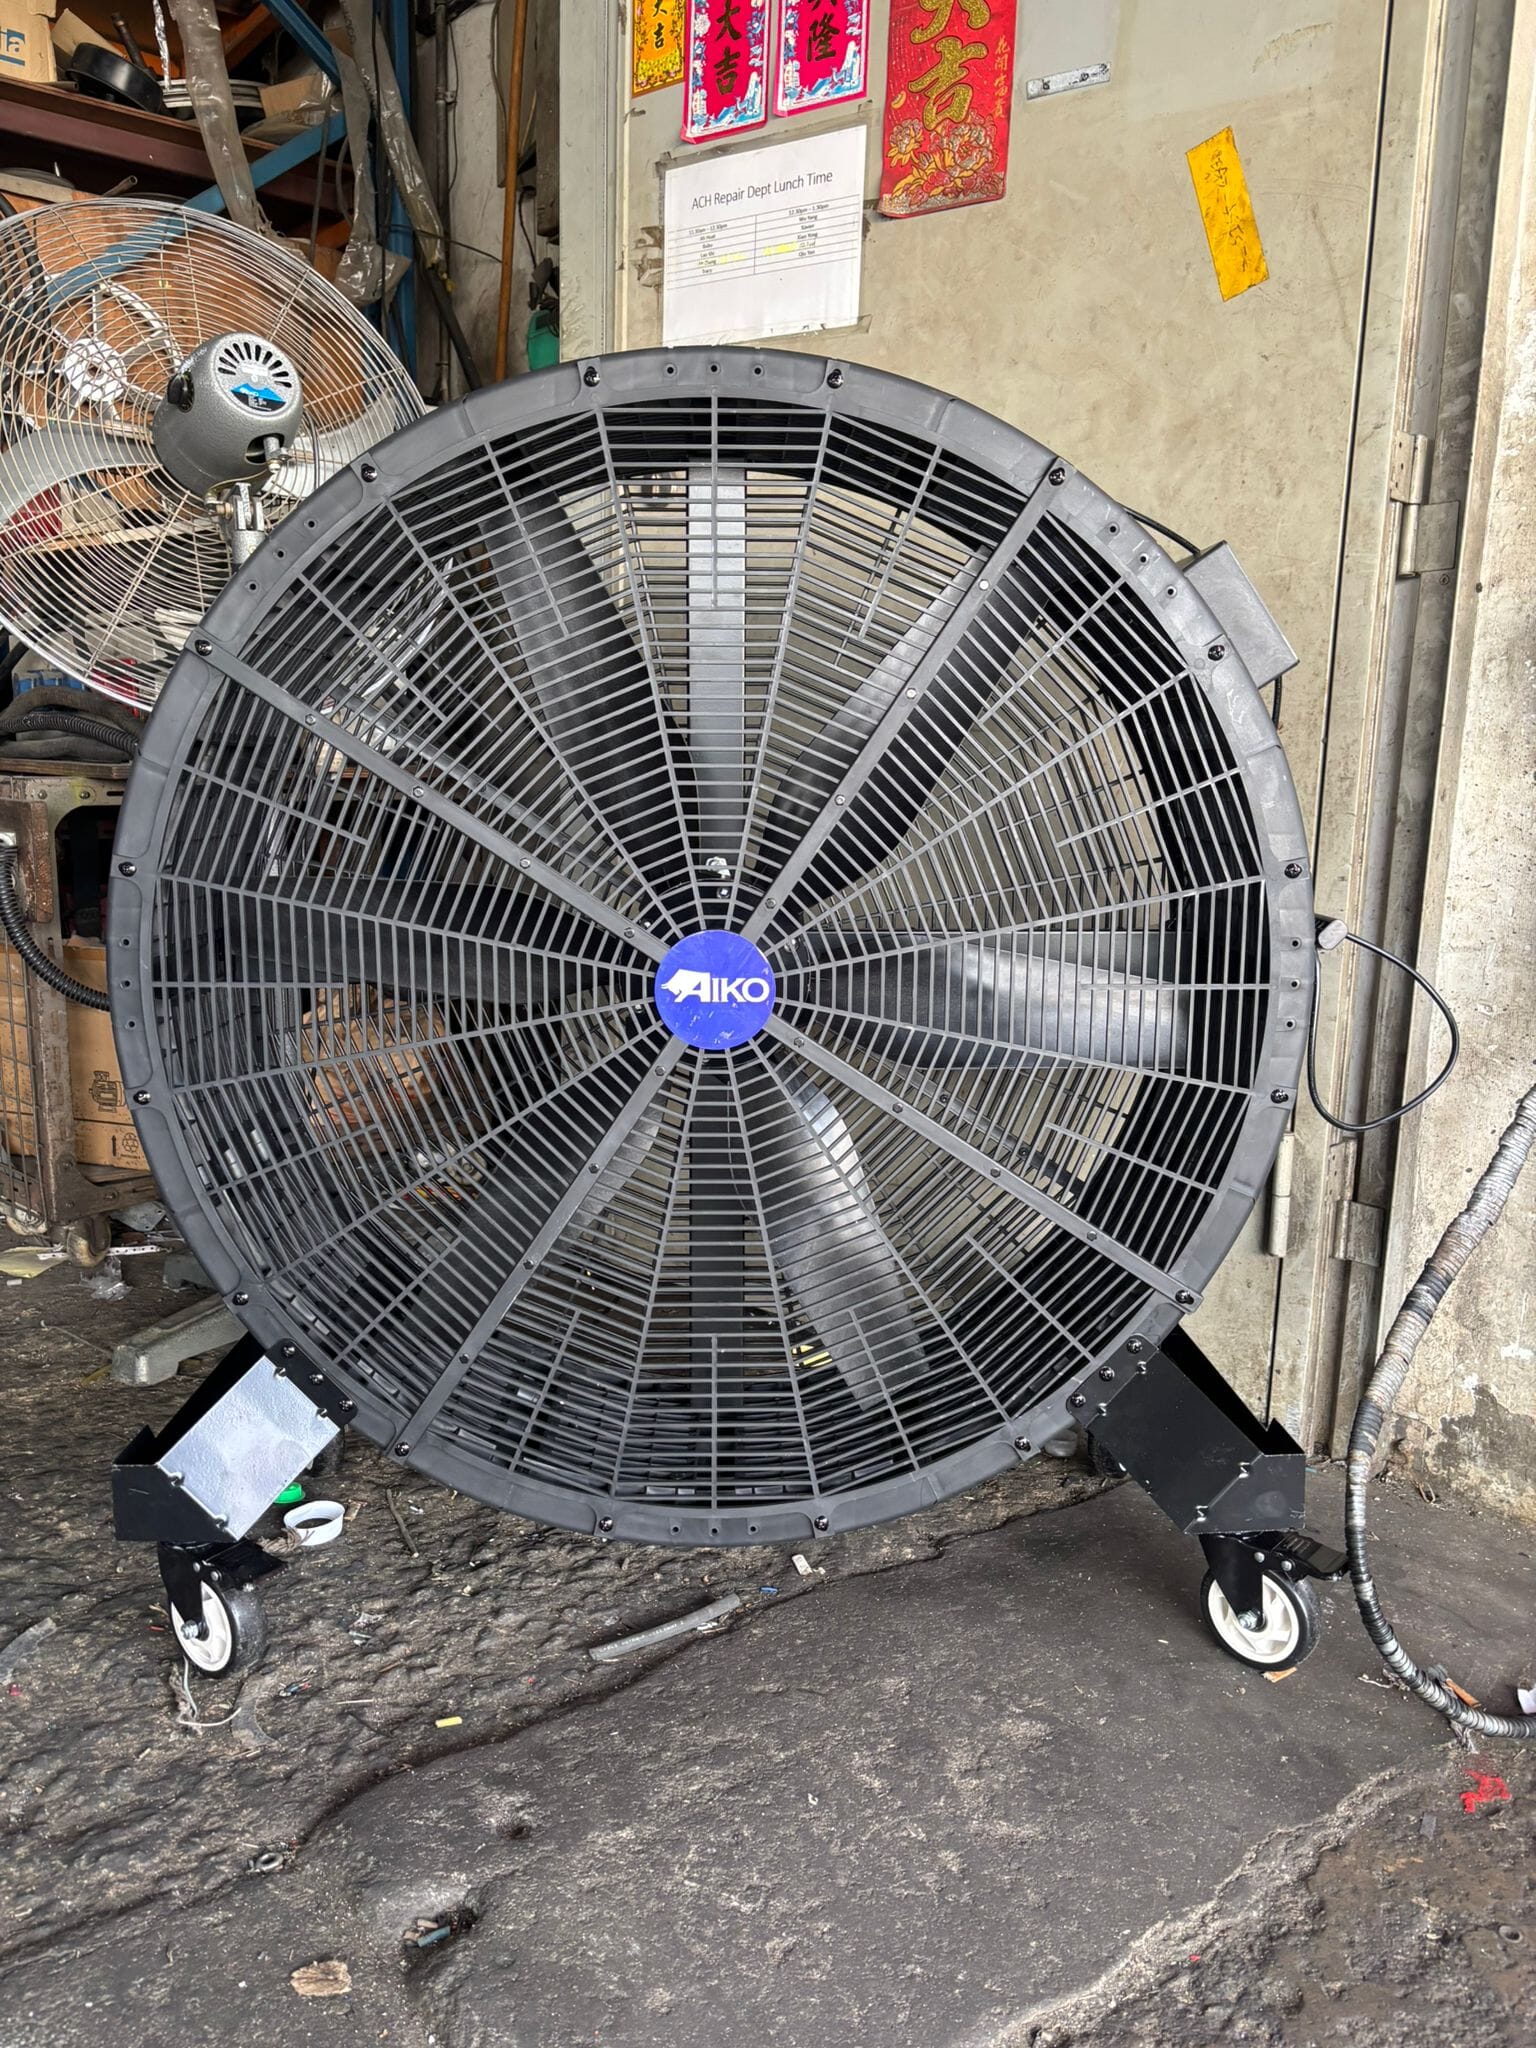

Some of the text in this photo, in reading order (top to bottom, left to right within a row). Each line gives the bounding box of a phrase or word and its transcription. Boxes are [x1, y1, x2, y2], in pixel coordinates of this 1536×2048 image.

[713, 3, 742, 95] 大吉
[692, 171, 833, 210] ACH Repair Dept Lunch Time
[660, 968, 770, 1003] AIKO
